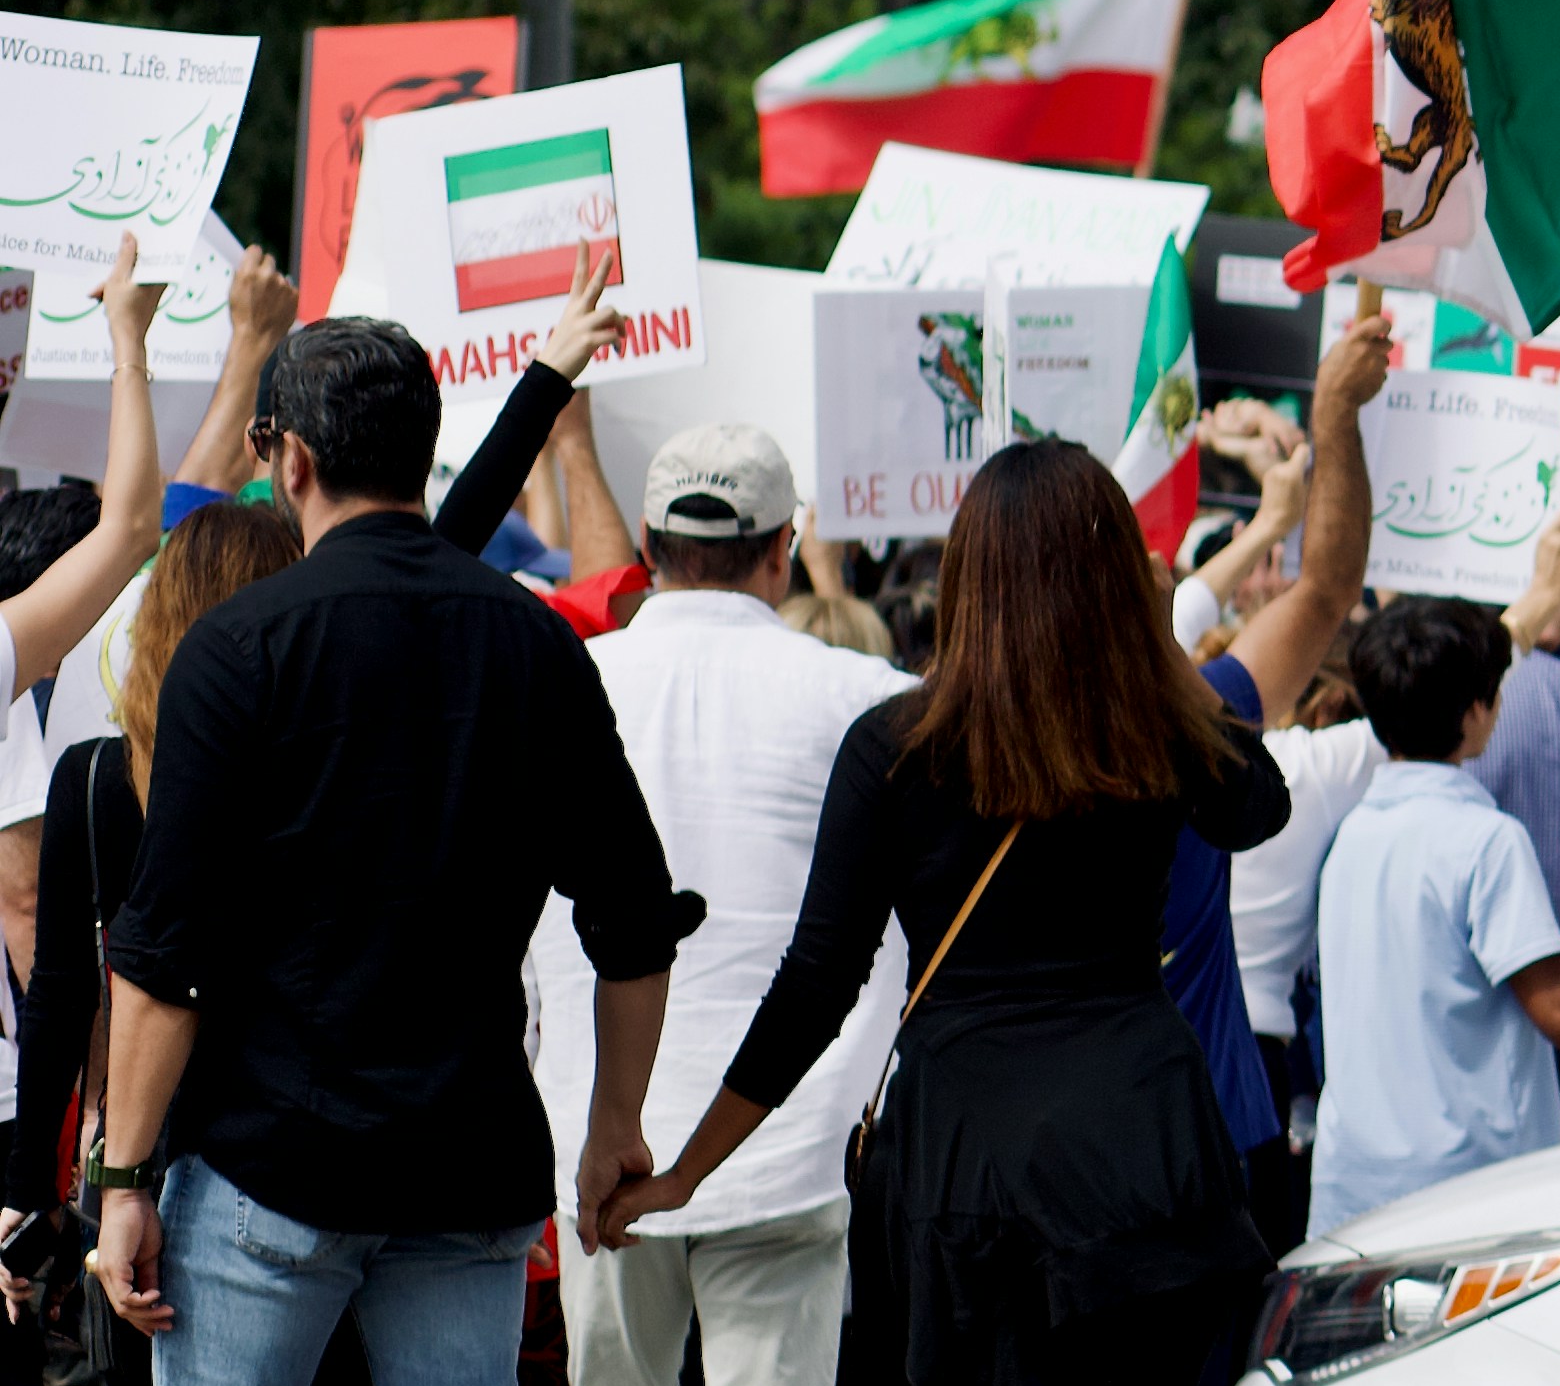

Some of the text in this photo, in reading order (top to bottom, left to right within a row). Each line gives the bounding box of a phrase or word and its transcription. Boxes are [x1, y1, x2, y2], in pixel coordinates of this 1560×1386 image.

[0, 36, 111, 74] Woman.
[120, 51, 170, 82] Life.
[33, 238, 61, 258] for
[66, 243, 118, 264] Mahs
[426, 305, 693, 385] MAHS MINI
[843, 469, 974, 520] BE OU
